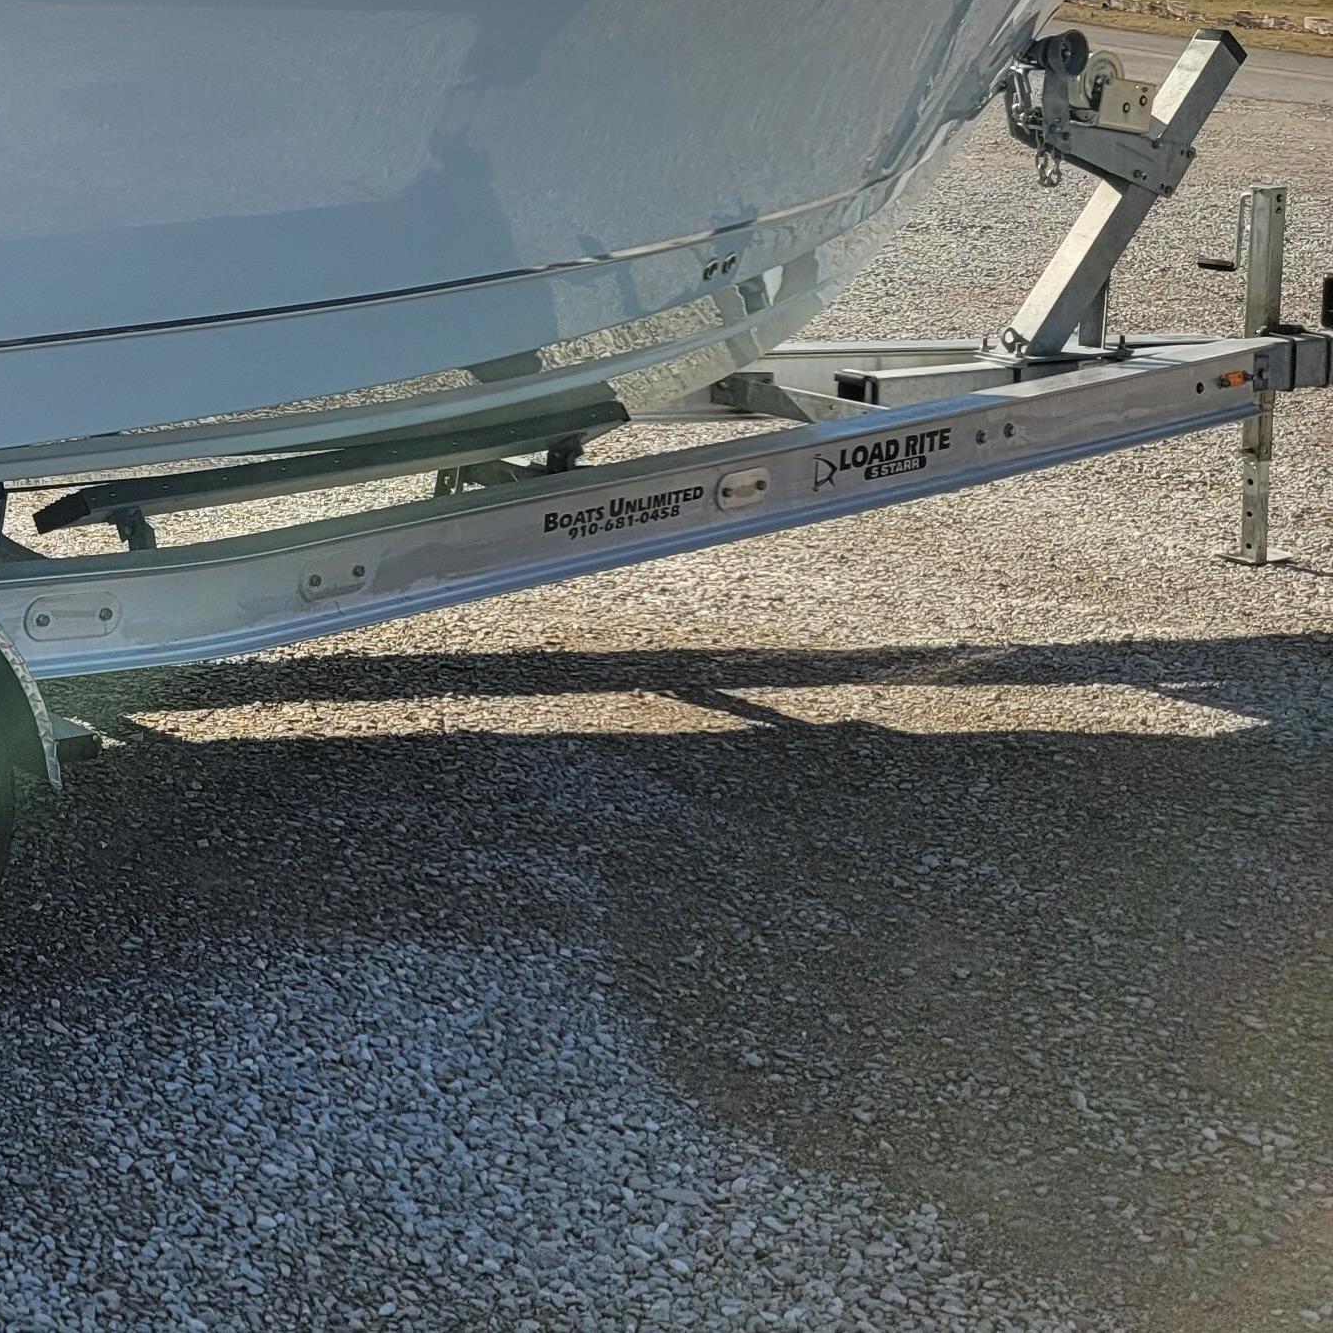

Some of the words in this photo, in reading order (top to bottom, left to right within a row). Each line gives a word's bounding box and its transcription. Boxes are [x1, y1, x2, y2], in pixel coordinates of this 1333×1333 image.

[839, 438, 900, 472] LOAD
[904, 427, 952, 458] RITE
[568, 504, 680, 541] 910-681-0458
